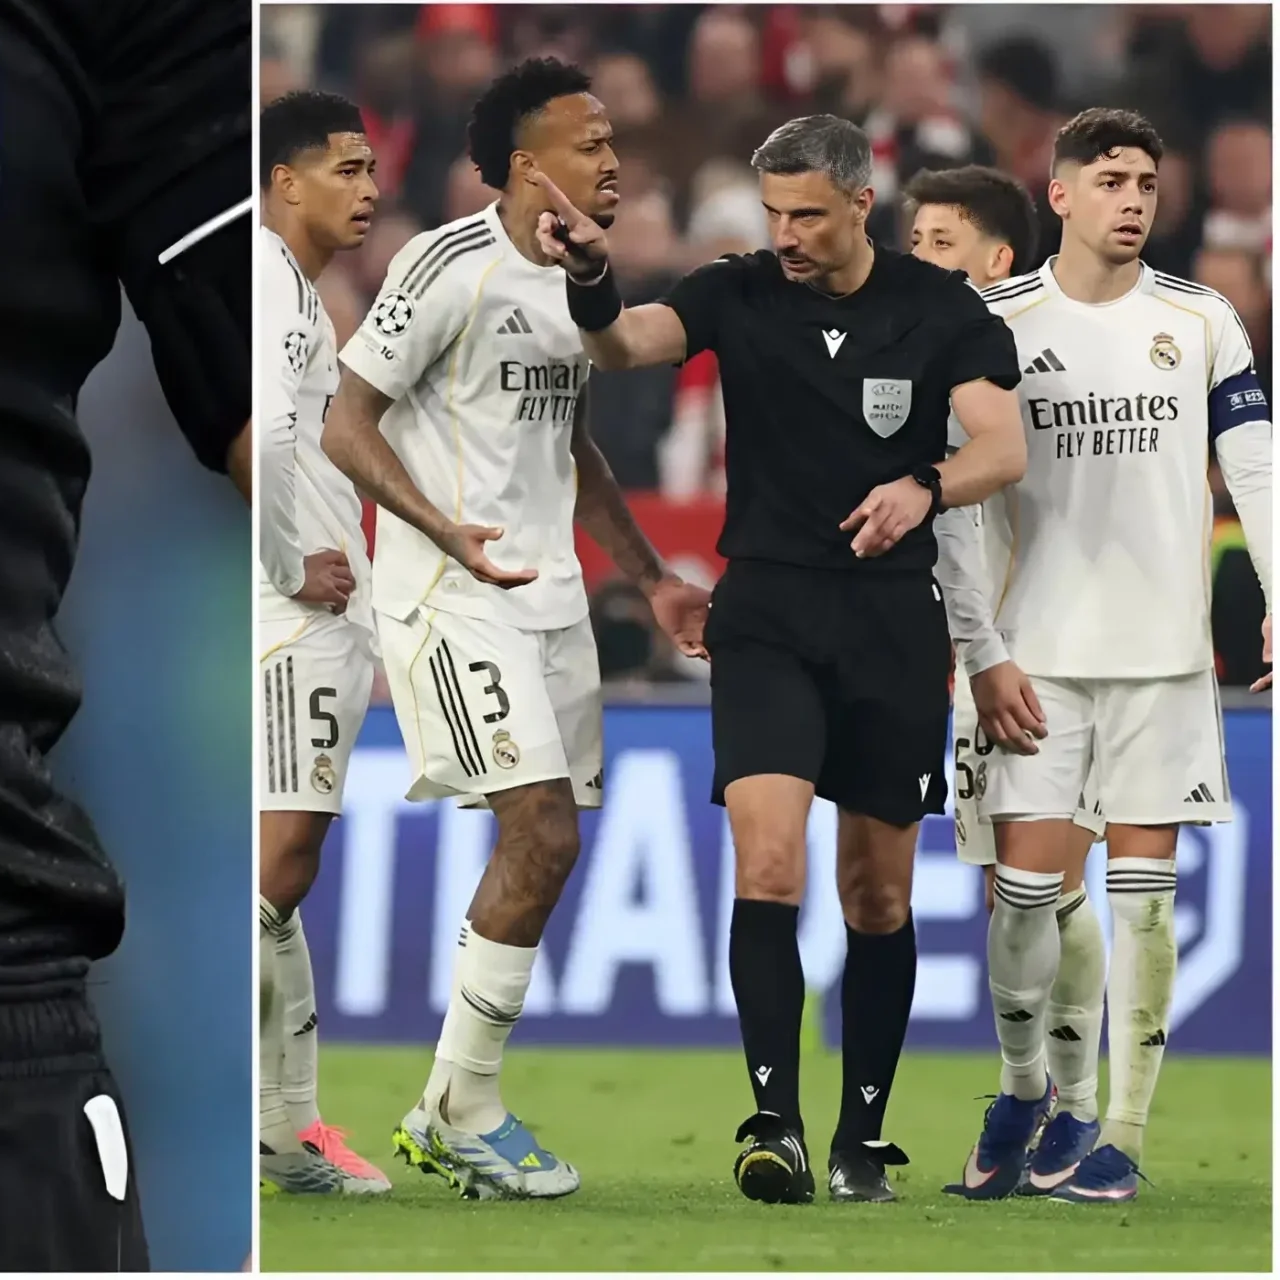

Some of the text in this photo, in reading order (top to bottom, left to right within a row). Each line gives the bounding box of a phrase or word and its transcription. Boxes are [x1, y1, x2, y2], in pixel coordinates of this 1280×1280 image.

[1027, 391, 1179, 430] Emirates
[1056, 427, 1159, 459] FLY BETTER
[469, 660, 511, 724] 3
[308, 687, 339, 749] 5
